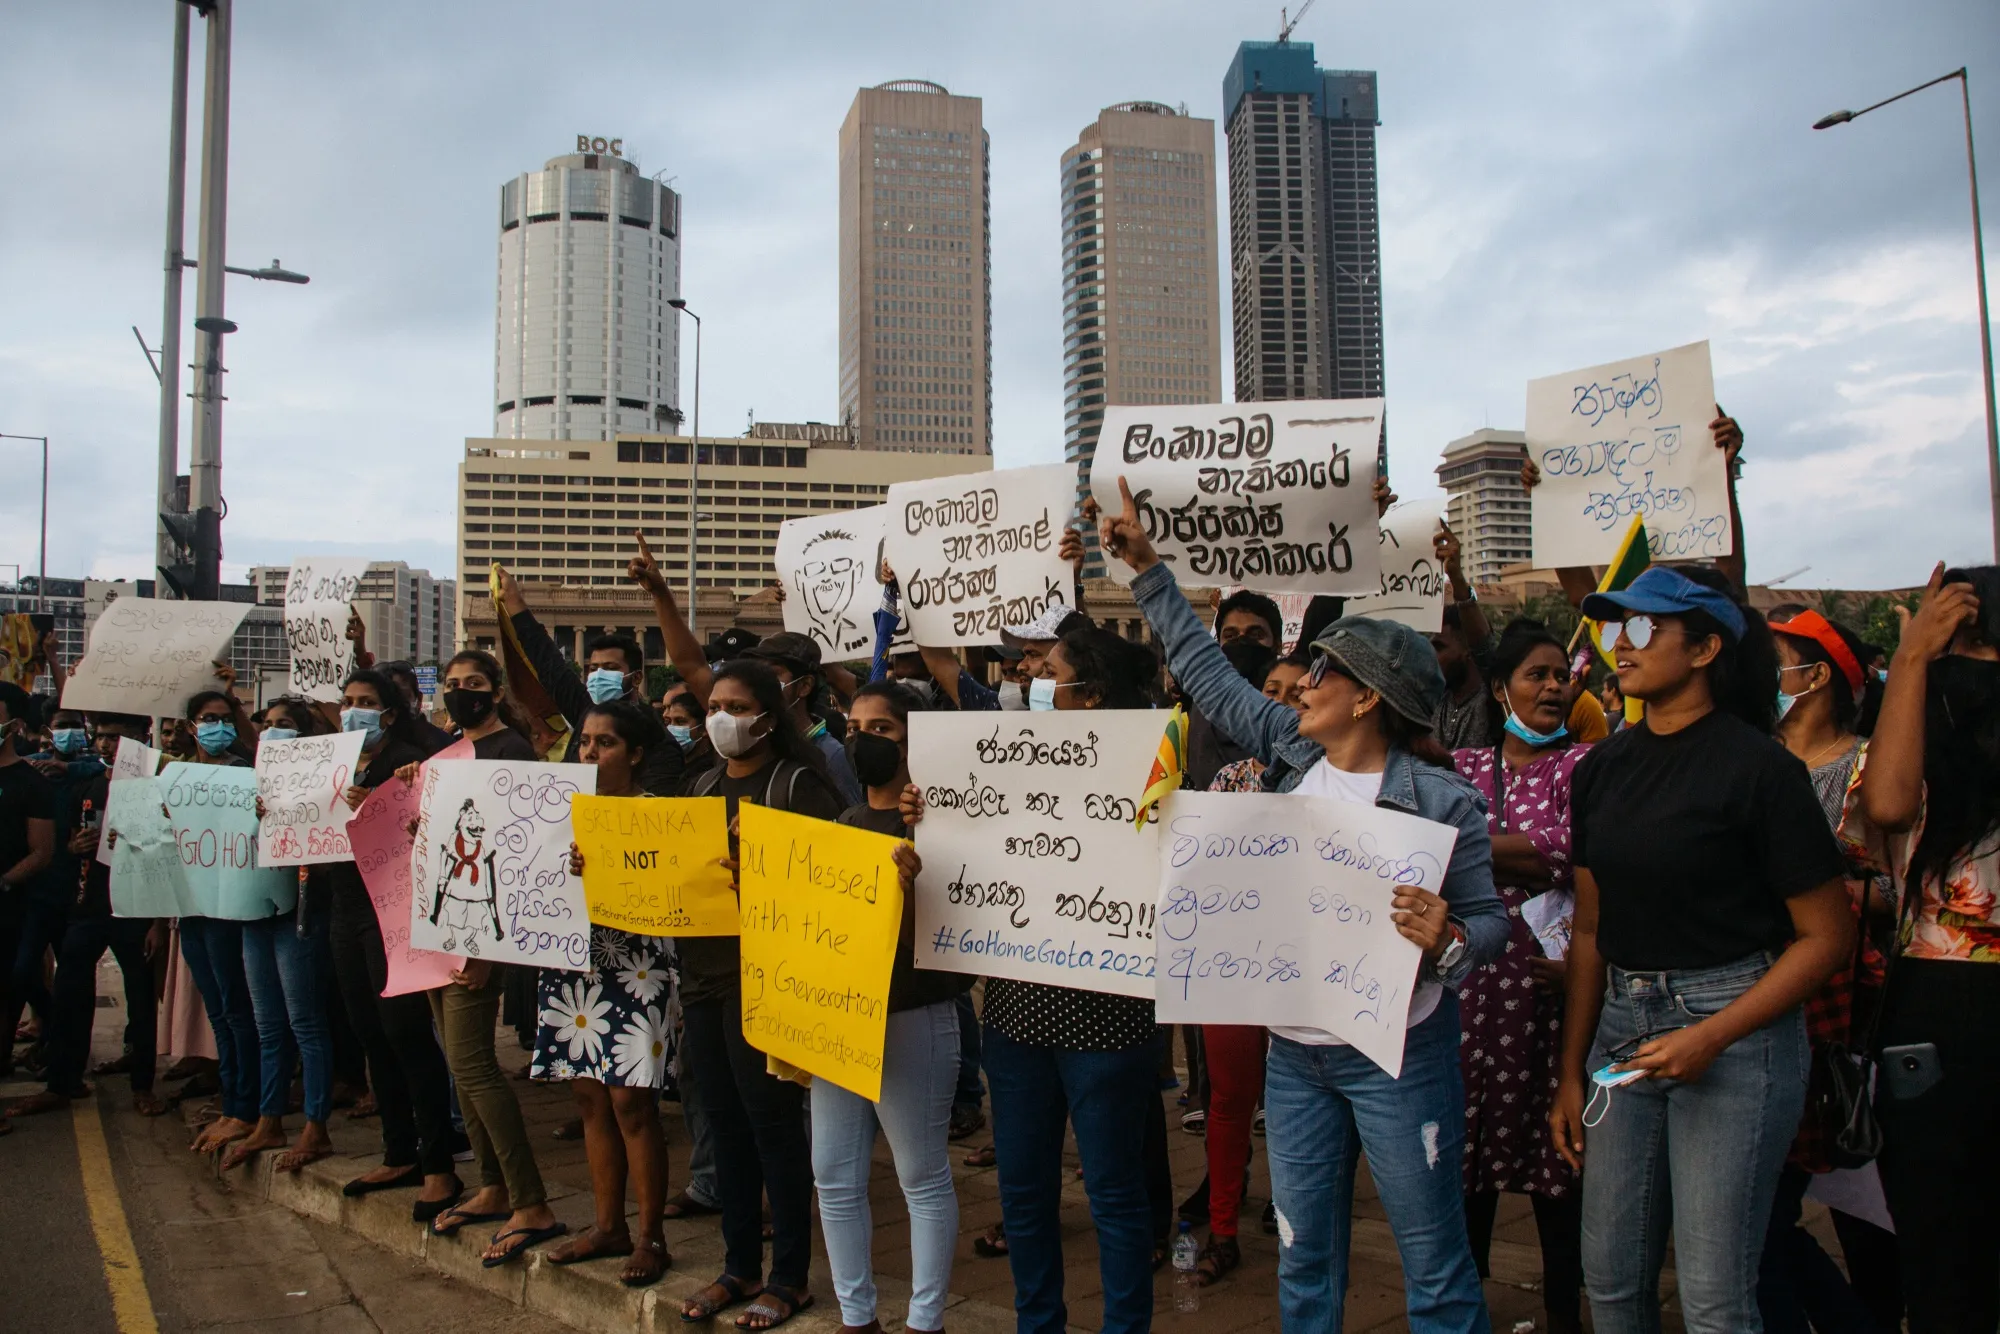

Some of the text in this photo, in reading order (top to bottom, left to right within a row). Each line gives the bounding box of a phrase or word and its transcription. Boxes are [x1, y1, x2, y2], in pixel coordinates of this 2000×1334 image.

[577, 134, 622, 156] BOC
[583, 808, 696, 838] SRI LANKA
[223, 832, 259, 870] HO
[624, 850, 659, 870] NOT
[669, 855, 680, 869] a
[787, 838, 879, 905] Messed
[802, 911, 849, 955] the
[774, 960, 883, 1021] Generation
